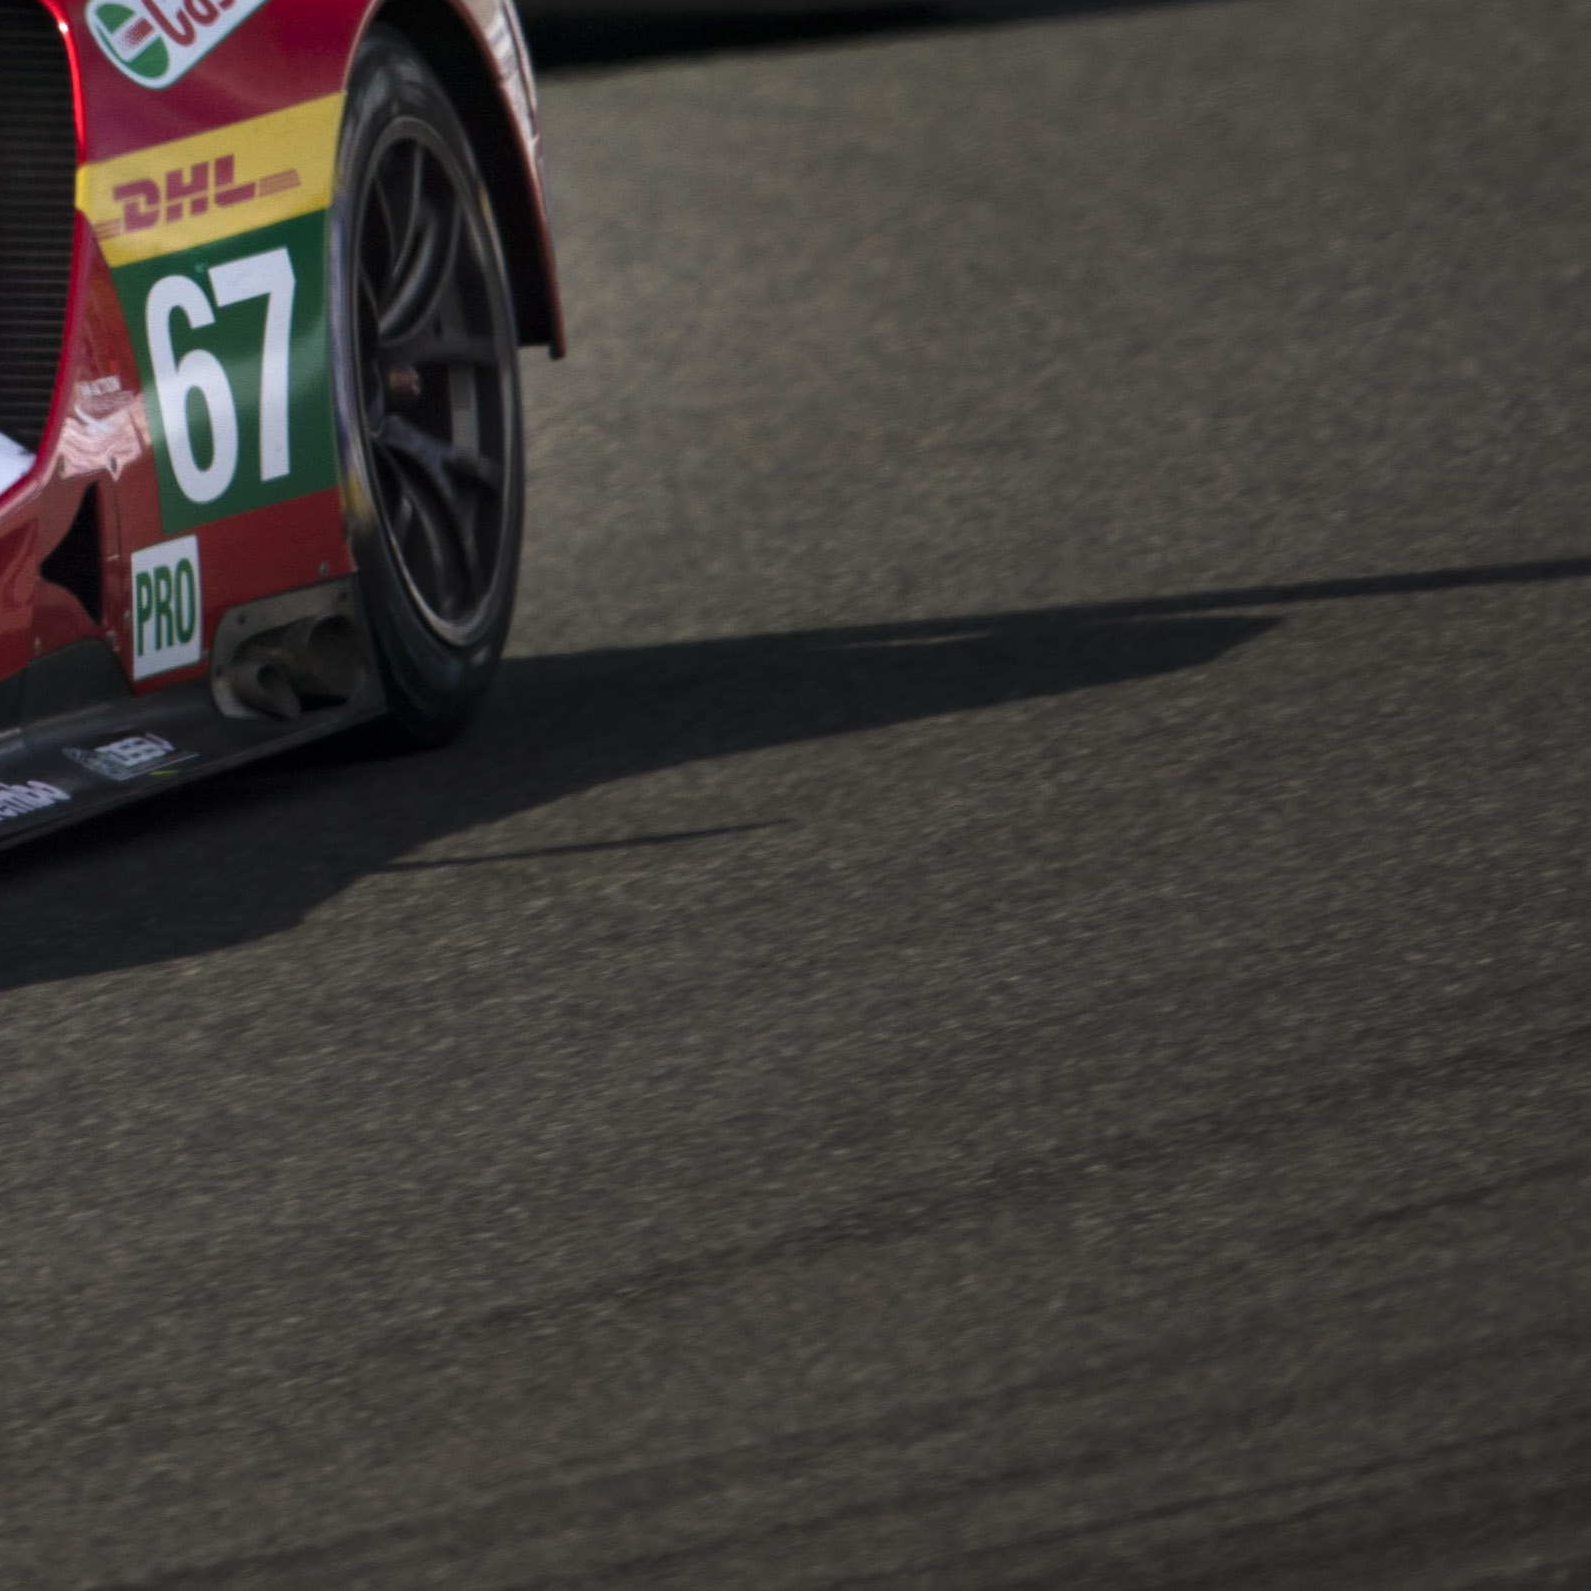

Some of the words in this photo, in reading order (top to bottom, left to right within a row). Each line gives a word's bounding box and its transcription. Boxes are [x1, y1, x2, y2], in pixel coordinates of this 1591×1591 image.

[113, 153, 256, 233] DHL
[146, 245, 295, 505] 67
[135, 556, 196, 656] PRO
